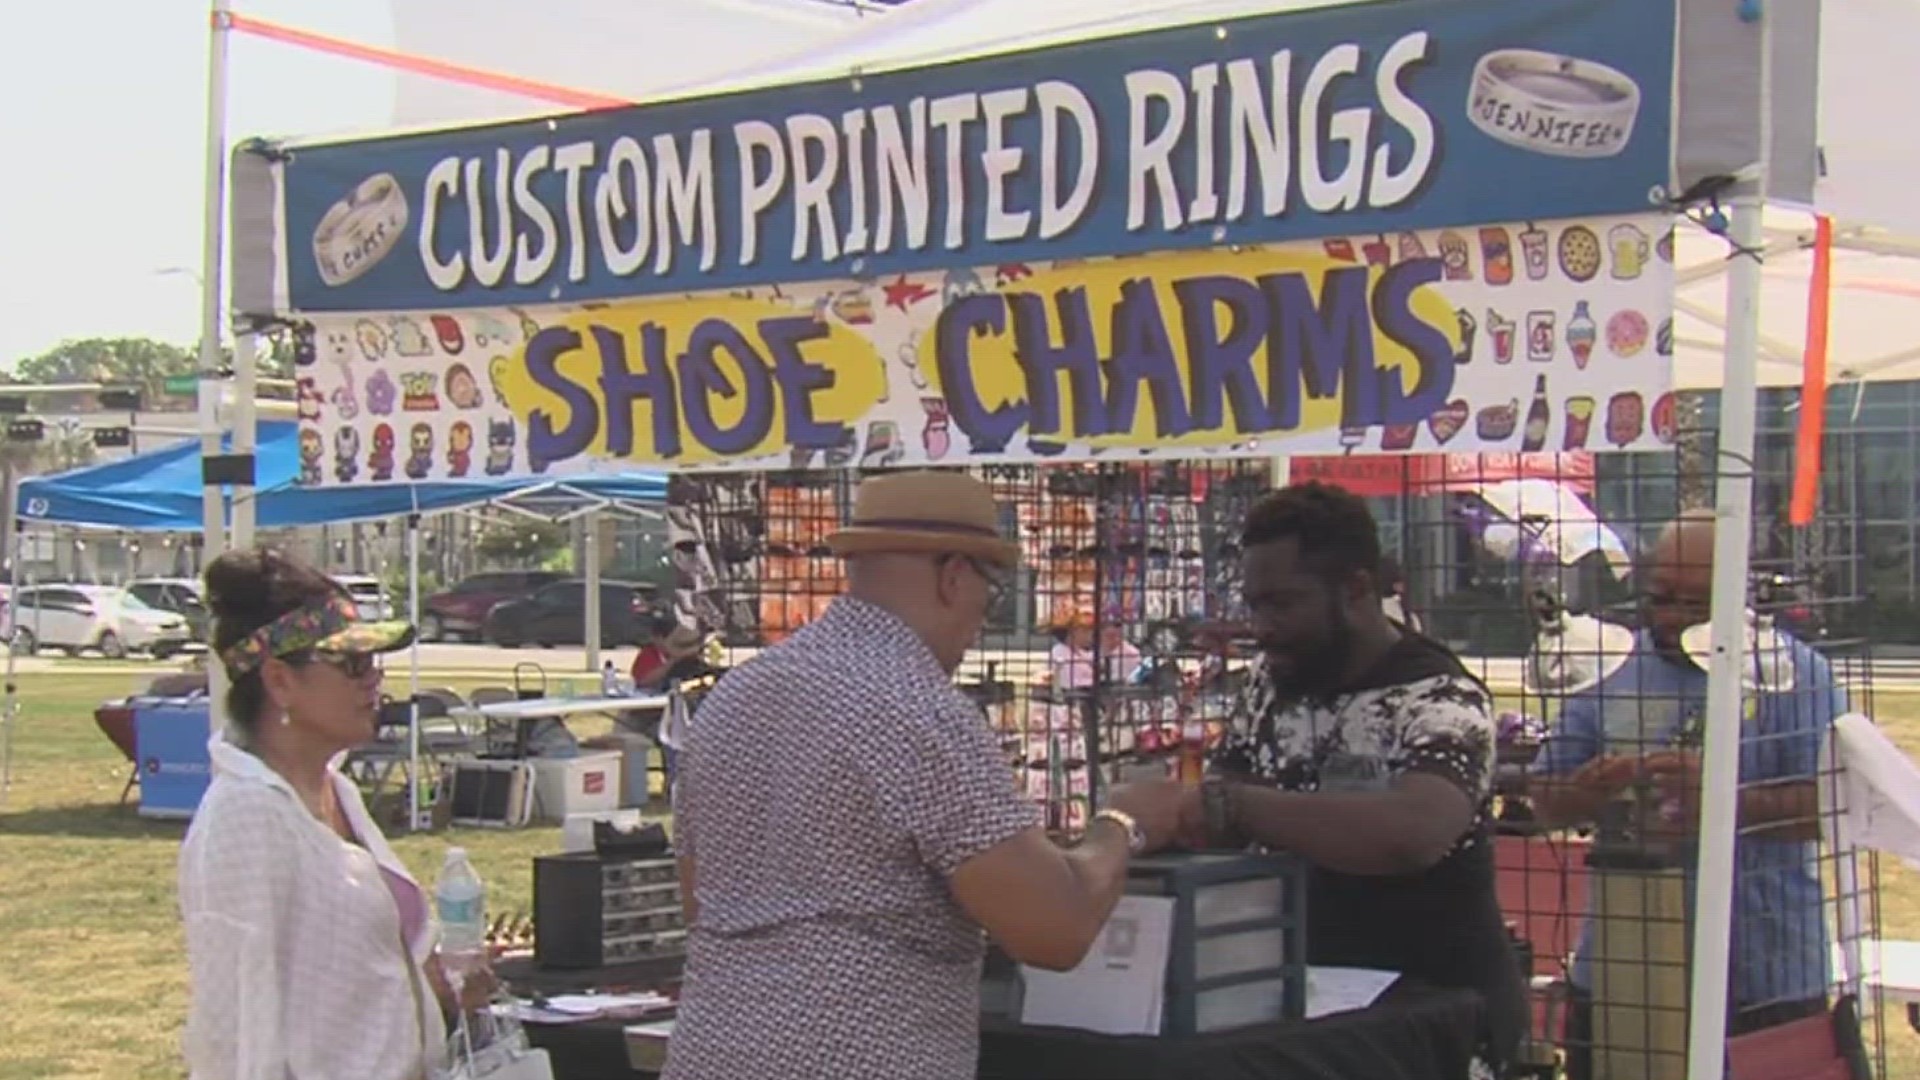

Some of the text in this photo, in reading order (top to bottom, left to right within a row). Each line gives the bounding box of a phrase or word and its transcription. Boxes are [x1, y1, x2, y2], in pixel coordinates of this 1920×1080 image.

[419, 31, 1436, 291] CUSTOM PRINTED RINGS
[524, 260, 1456, 472] SHOE CHARMS
